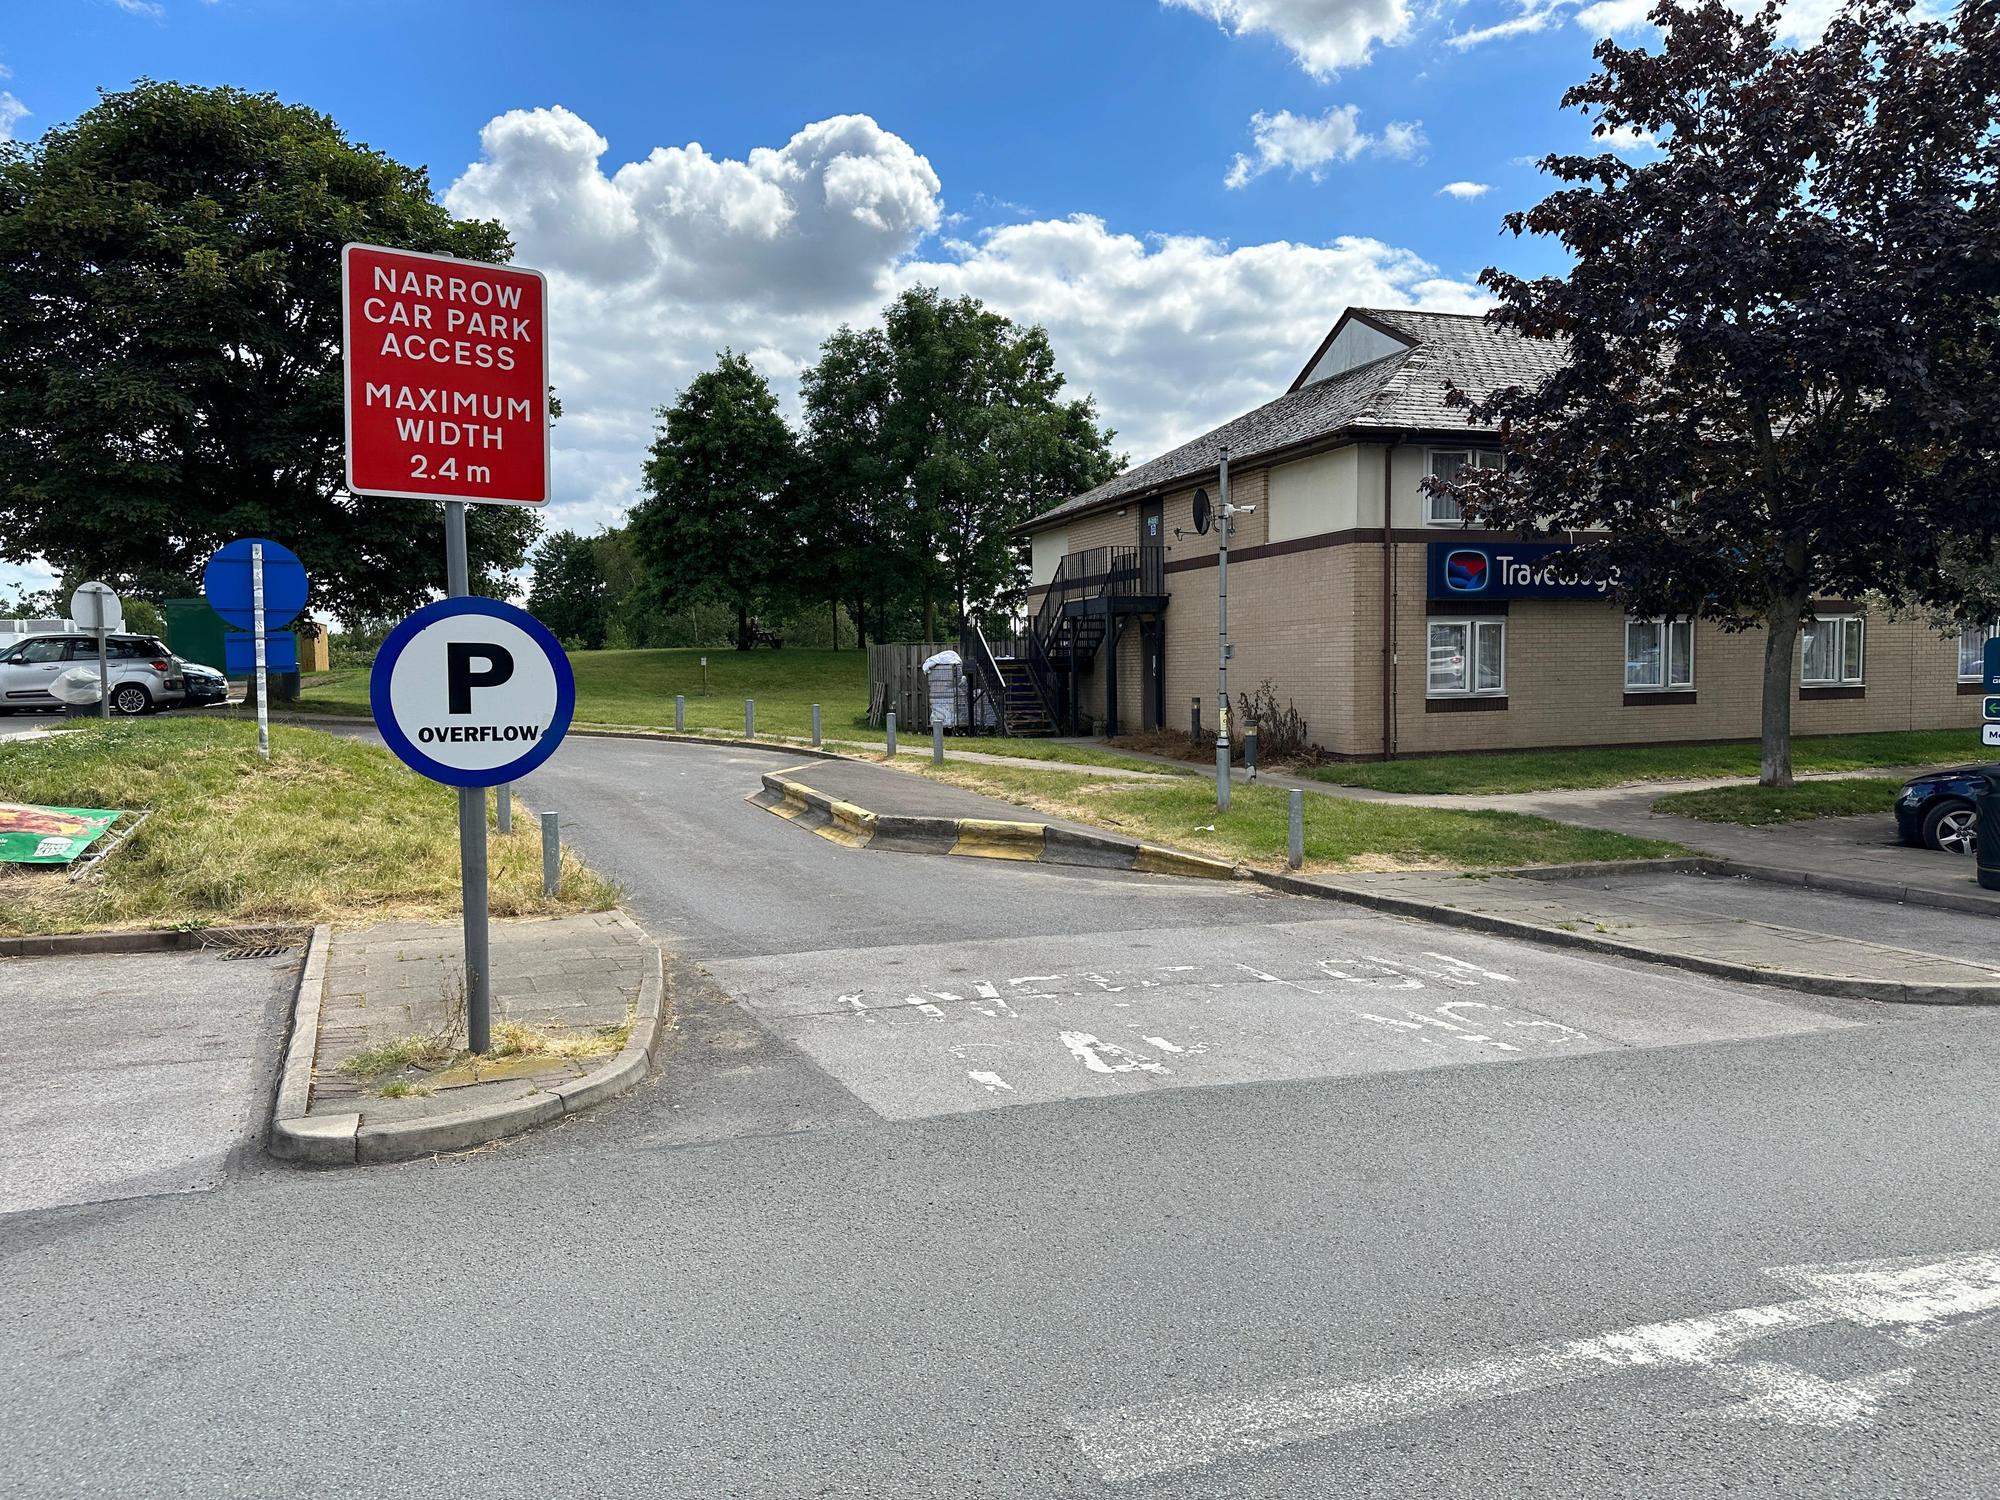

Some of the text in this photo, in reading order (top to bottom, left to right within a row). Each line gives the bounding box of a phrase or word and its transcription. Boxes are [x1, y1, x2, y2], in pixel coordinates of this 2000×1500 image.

[374, 266, 522, 310] NARROW
[363, 297, 531, 342] CAR PARK
[380, 332, 515, 371] ACCESS
[365, 382, 531, 422] MAXIMUM
[396, 417, 503, 450] WIDTH
[410, 454, 491, 483] 2.4 m
[447, 642, 515, 715] P
[418, 725, 539, 743] OVERFLOW
